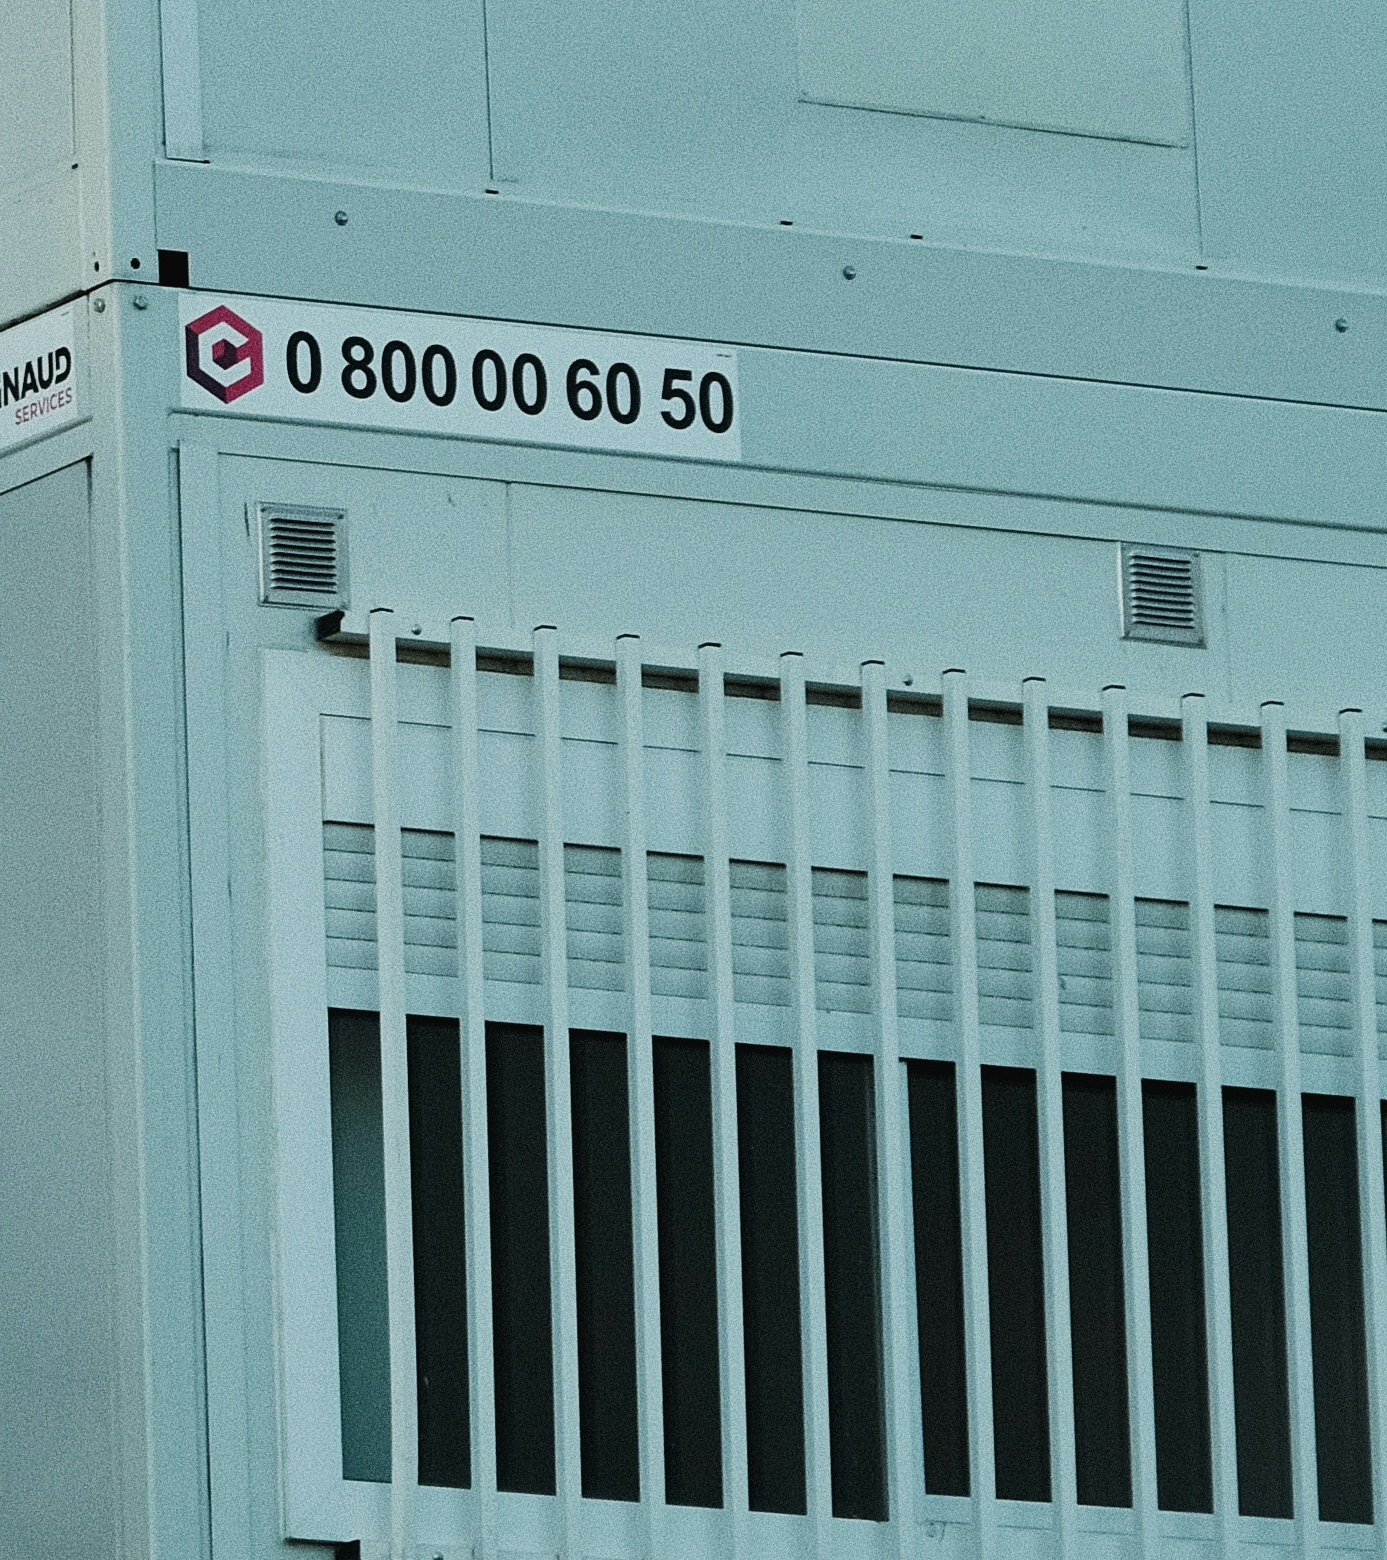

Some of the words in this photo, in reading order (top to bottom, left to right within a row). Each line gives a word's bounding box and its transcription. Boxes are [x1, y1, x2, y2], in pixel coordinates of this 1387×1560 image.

[15, 387, 72, 425] SERVICES
[286, 331, 321, 393] 0
[341, 336, 456, 406] 800
[472, 349, 547, 415] 00
[566, 359, 640, 424] 60
[661, 368, 733, 433] 50
